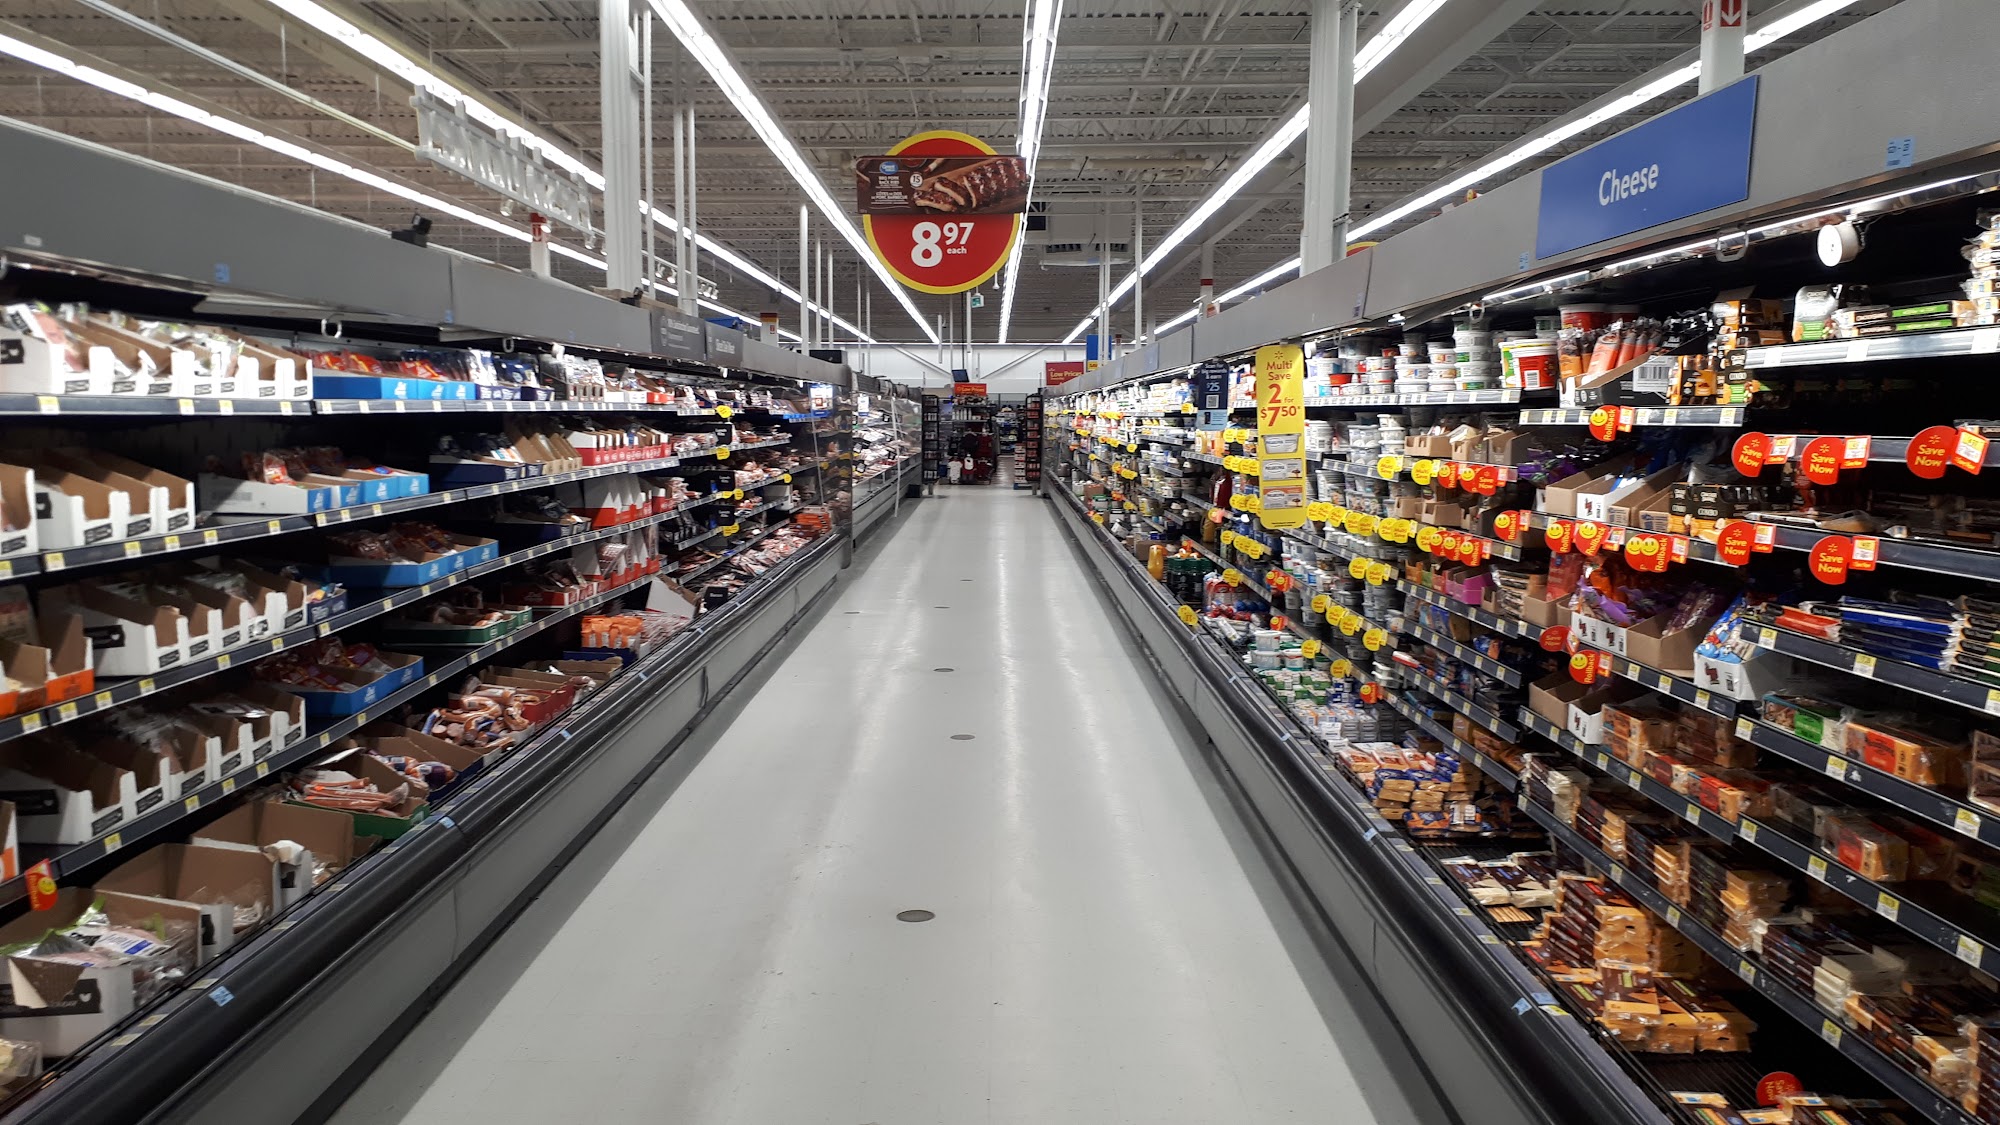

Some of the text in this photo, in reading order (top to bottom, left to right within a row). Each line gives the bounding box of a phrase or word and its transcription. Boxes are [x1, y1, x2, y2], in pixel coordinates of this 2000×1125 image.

[912, 175, 921, 183] 15
[1599, 163, 1659, 206] Cheese
[946, 245, 967, 255] each
[1266, 360, 1292, 370] Multi
[1268, 371, 1292, 381] Save
[1206, 381, 1220, 392] $25
[1268, 383, 1282, 404] 2
[1603, 408, 1616, 441] Rollback
[1742, 444, 1763, 459] Save
[1917, 444, 1945, 456] Save
[1738, 454, 1760, 468] Now
[1811, 452, 1836, 464] Save
[1914, 455, 1942, 467] Now
[1809, 463, 1835, 474] Now
[1507, 513, 1517, 541] Rollback
[1560, 523, 1571, 553] Rollback
[1585, 527, 1607, 555] Rollback
[1725, 536, 1747, 547] Save
[1655, 537, 1668, 571] Rollback
[1724, 546, 1746, 556] Now
[1819, 552, 1844, 563] Save
[1818, 563, 1842, 574] Now
[1584, 653, 1596, 683] Rollback
